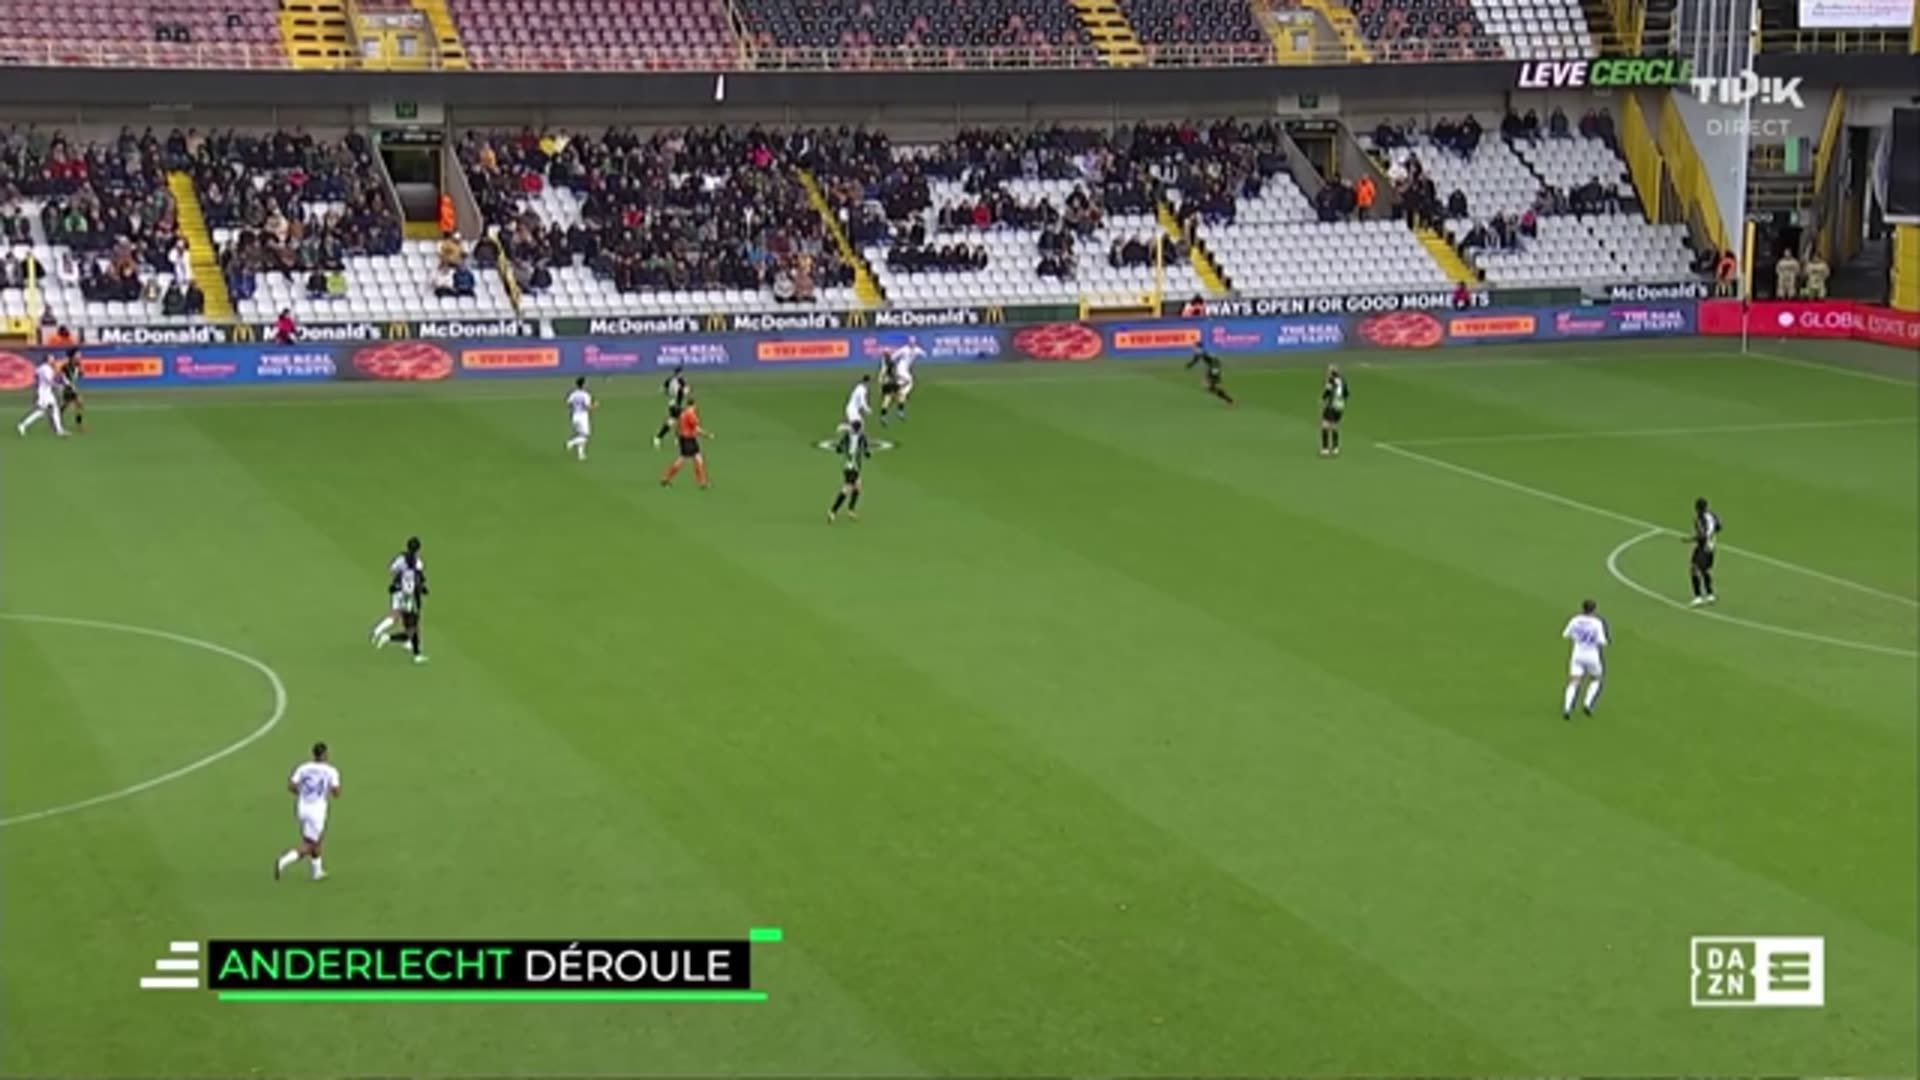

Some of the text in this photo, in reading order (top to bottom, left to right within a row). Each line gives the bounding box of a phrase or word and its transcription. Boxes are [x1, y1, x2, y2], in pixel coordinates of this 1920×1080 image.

[1518, 62, 1587, 88] LEVE
[1611, 284, 1708, 300] McDonald's
[1256, 299, 1304, 315] OPEN
[1307, 297, 1342, 313] FOR
[1346, 295, 1399, 312] GOOD
[1402, 292, 1489, 310] MOMETS
[589, 317, 700, 334] McDonald's
[733, 313, 841, 330] McDonald's
[875, 308, 980, 326] McDonald's
[101, 325, 226, 343] McDonald's
[263, 323, 381, 341] MDonald's
[419, 321, 534, 338] McDonald's
